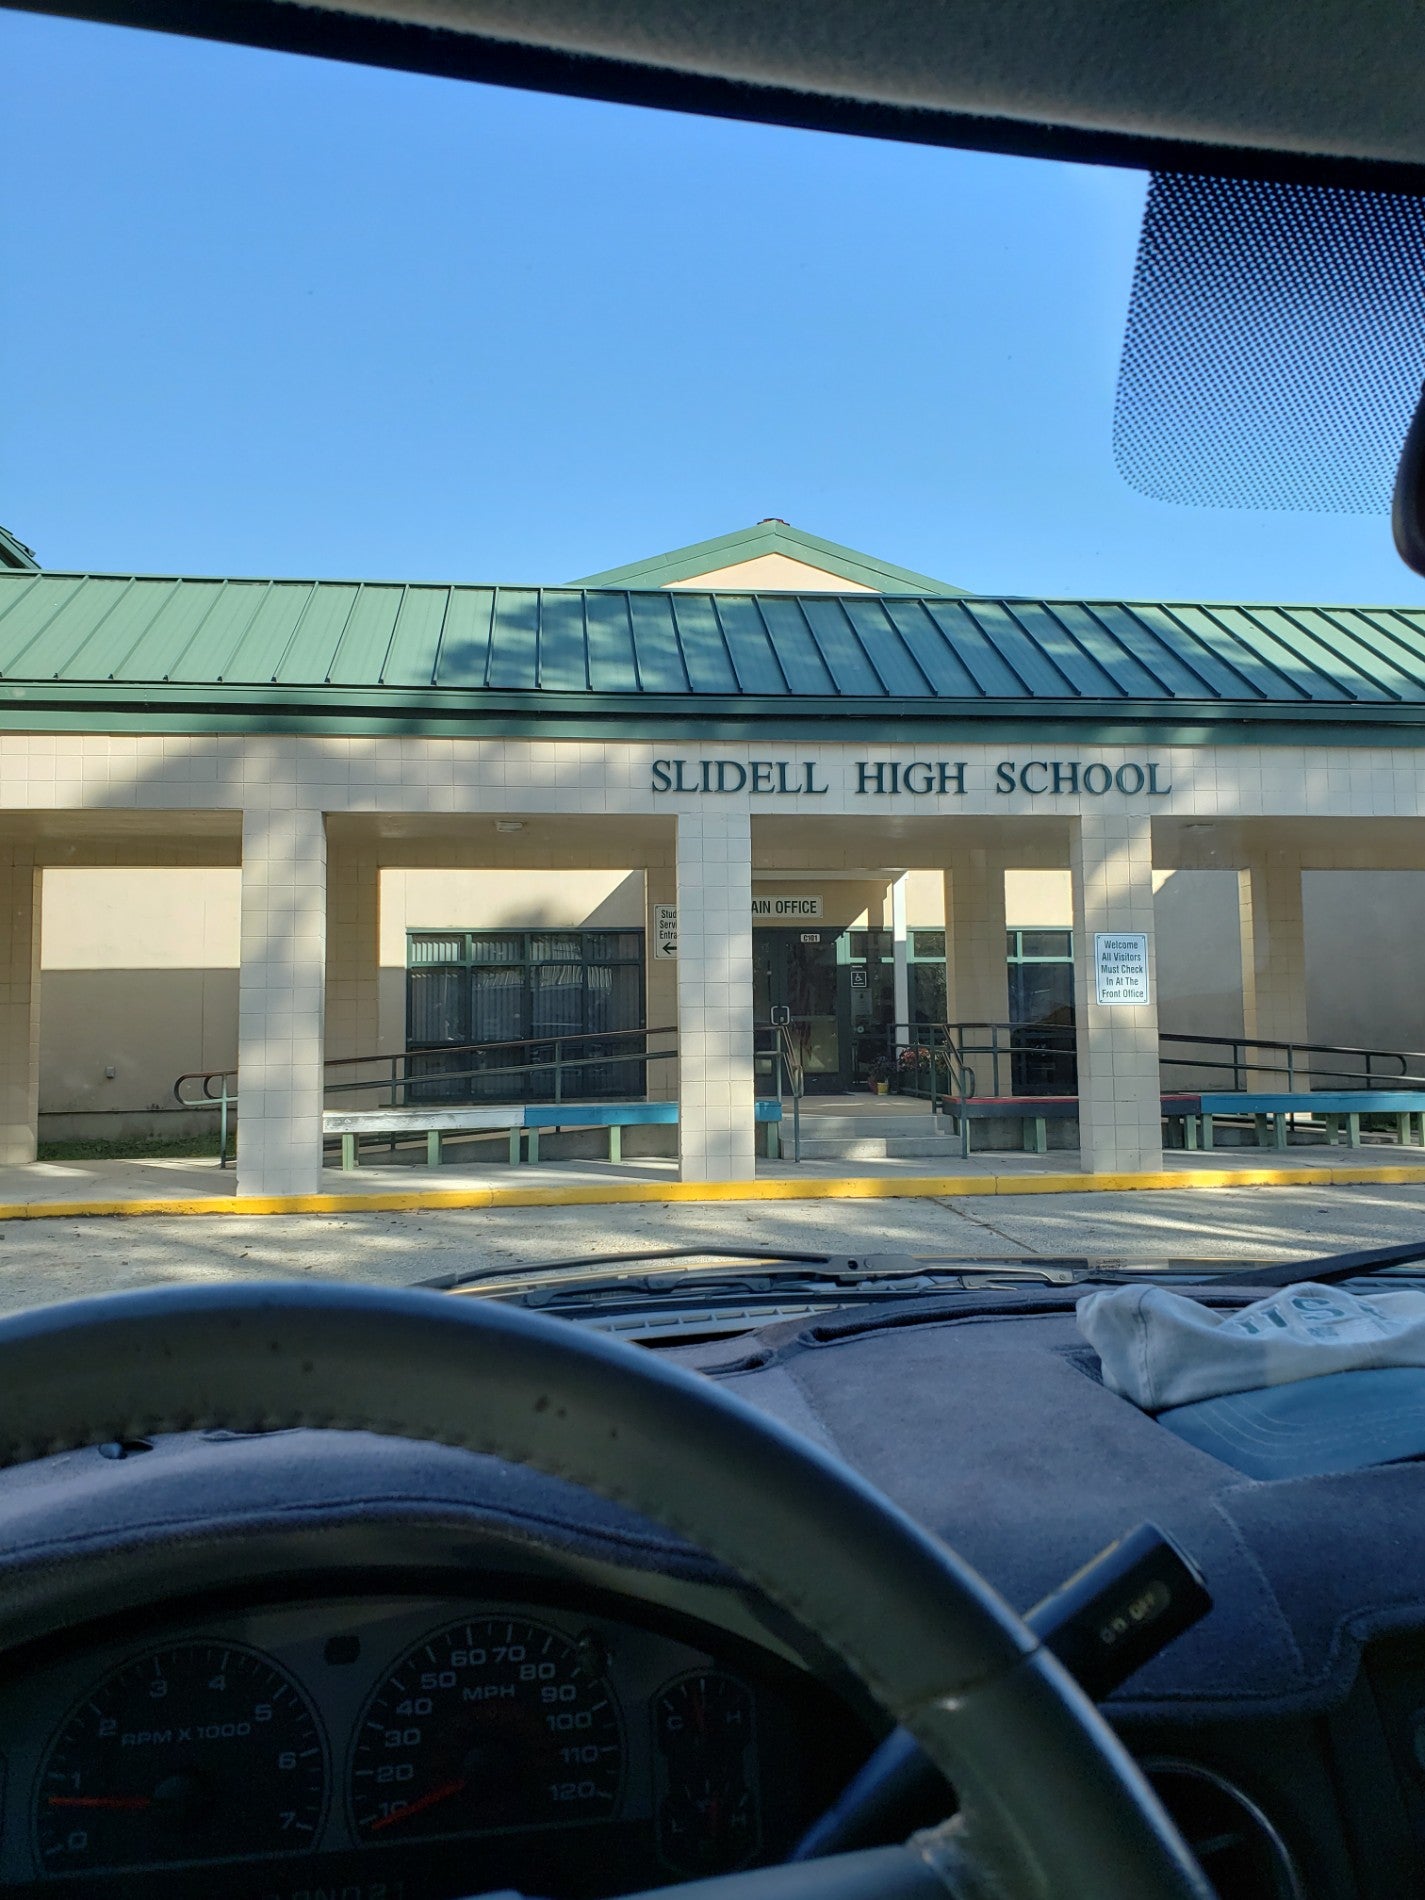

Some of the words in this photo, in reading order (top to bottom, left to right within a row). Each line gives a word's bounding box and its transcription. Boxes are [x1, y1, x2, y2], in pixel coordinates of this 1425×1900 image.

[651, 759, 829, 794] SLIDELL
[854, 761, 968, 795] HIGH
[996, 761, 1173, 795] SCHOOL
[775, 900, 817, 914] OFFICE
[1104, 940, 1138, 949] Welcome
[1102, 953, 1111, 961] All
[1113, 953, 1141, 961] Visitors
[1101, 965, 1119, 973] Must
[1121, 965, 1143, 973] Check
[1106, 977, 1113, 985] In
[1116, 977, 1123, 985] At
[1126, 977, 1138, 985] The
[1102, 989, 1121, 998] Front
[1123, 989, 1144, 998] Office
[450, 1648, 487, 1667] 60
[493, 1645, 526, 1663] 70
[419, 1670, 457, 1690] 50
[518, 1662, 556, 1681] 80
[149, 1678, 168, 1698] 3
[207, 1673, 226, 1691] 4
[462, 1684, 517, 1701] MPH
[540, 1684, 577, 1703] 90
[254, 1703, 273, 1722] 5
[395, 1697, 433, 1717] 40
[99, 1717, 118, 1738] 2
[545, 1711, 593, 1731] 100
[121, 1730, 173, 1747] RPM
[197, 1722, 251, 1740] 1000
[384, 1728, 422, 1748] 30
[277, 1751, 297, 1770] 6
[561, 1745, 601, 1765] 110
[373, 1763, 414, 1783] 20
[551, 1780, 597, 1800] 120
[278, 1810, 296, 1830] 7
[67, 1830, 88, 1850] 0
